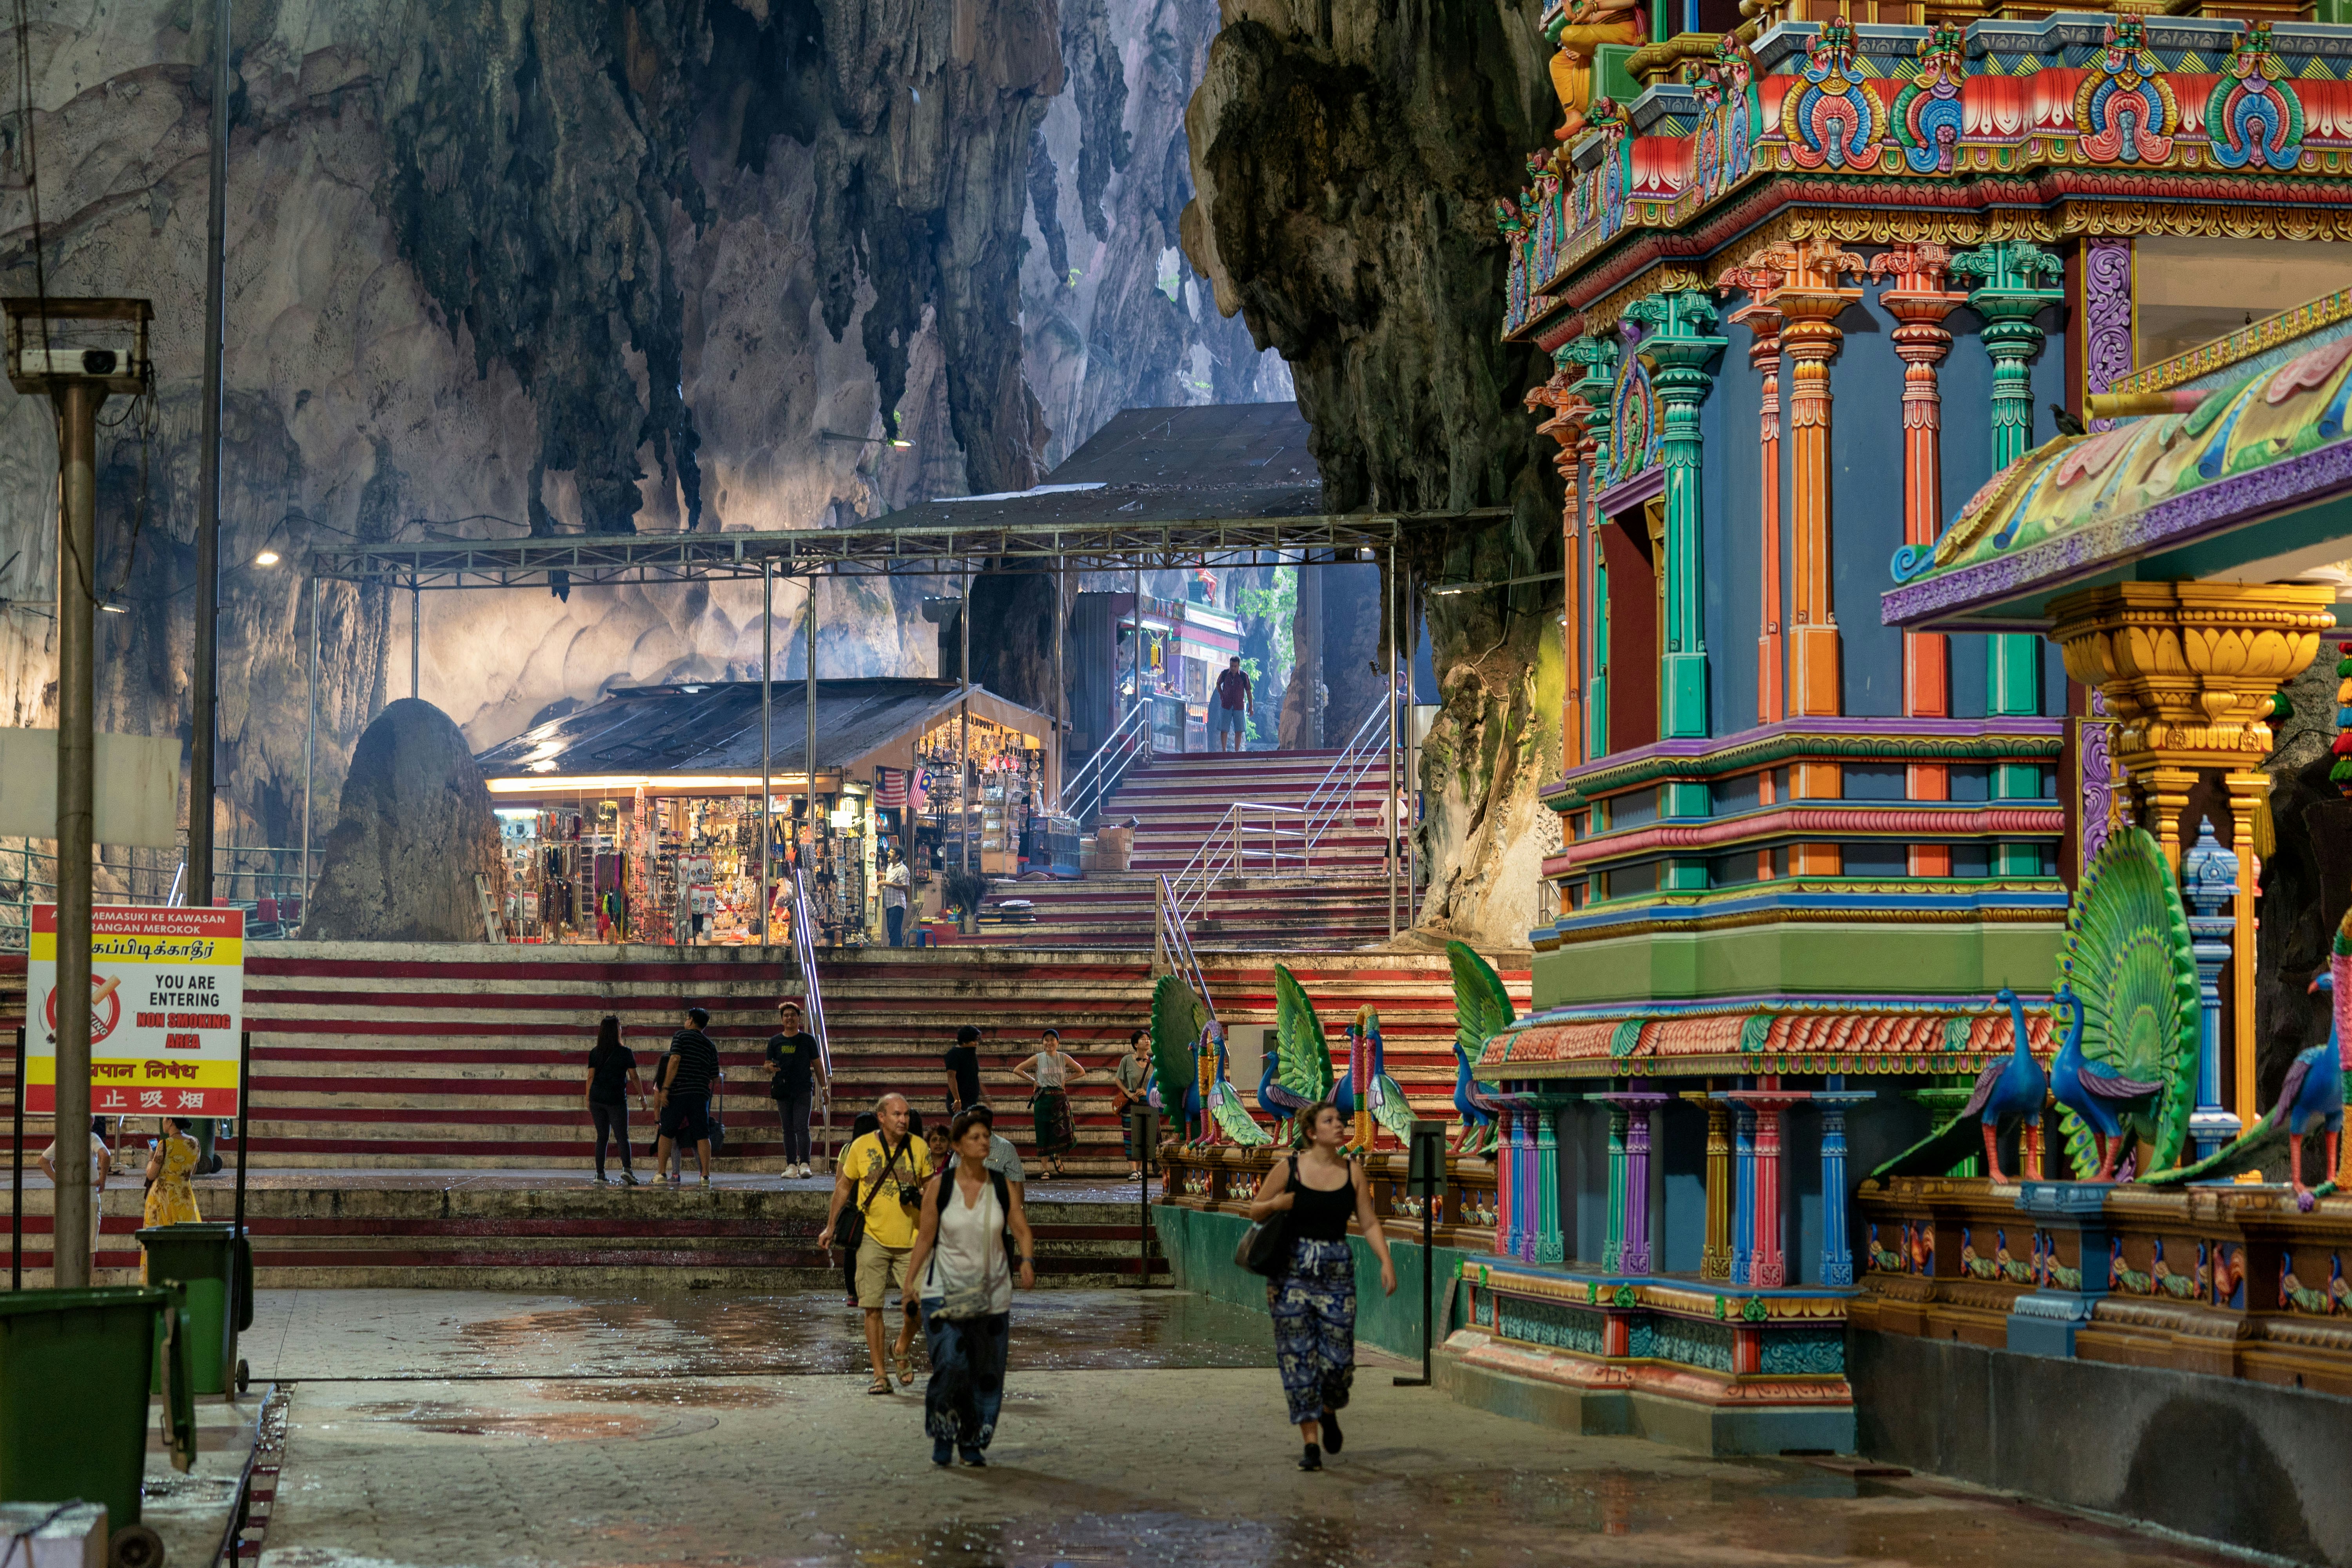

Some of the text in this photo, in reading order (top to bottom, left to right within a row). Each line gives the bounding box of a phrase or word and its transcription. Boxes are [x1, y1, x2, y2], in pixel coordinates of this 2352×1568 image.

[91, 912, 226, 924] MEMASUKI KE KAWASAN
[91, 923, 201, 934] RANGAN MEROKOK
[156, 975, 215, 989] YOU ARE
[150, 992, 220, 1007] ENTERING
[136, 1012, 231, 1029] NON SMOKING
[165, 1033, 201, 1049] AREA
[144, 1060, 199, 1079] निषेध
[100, 1089, 204, 1109] 止吸烟
